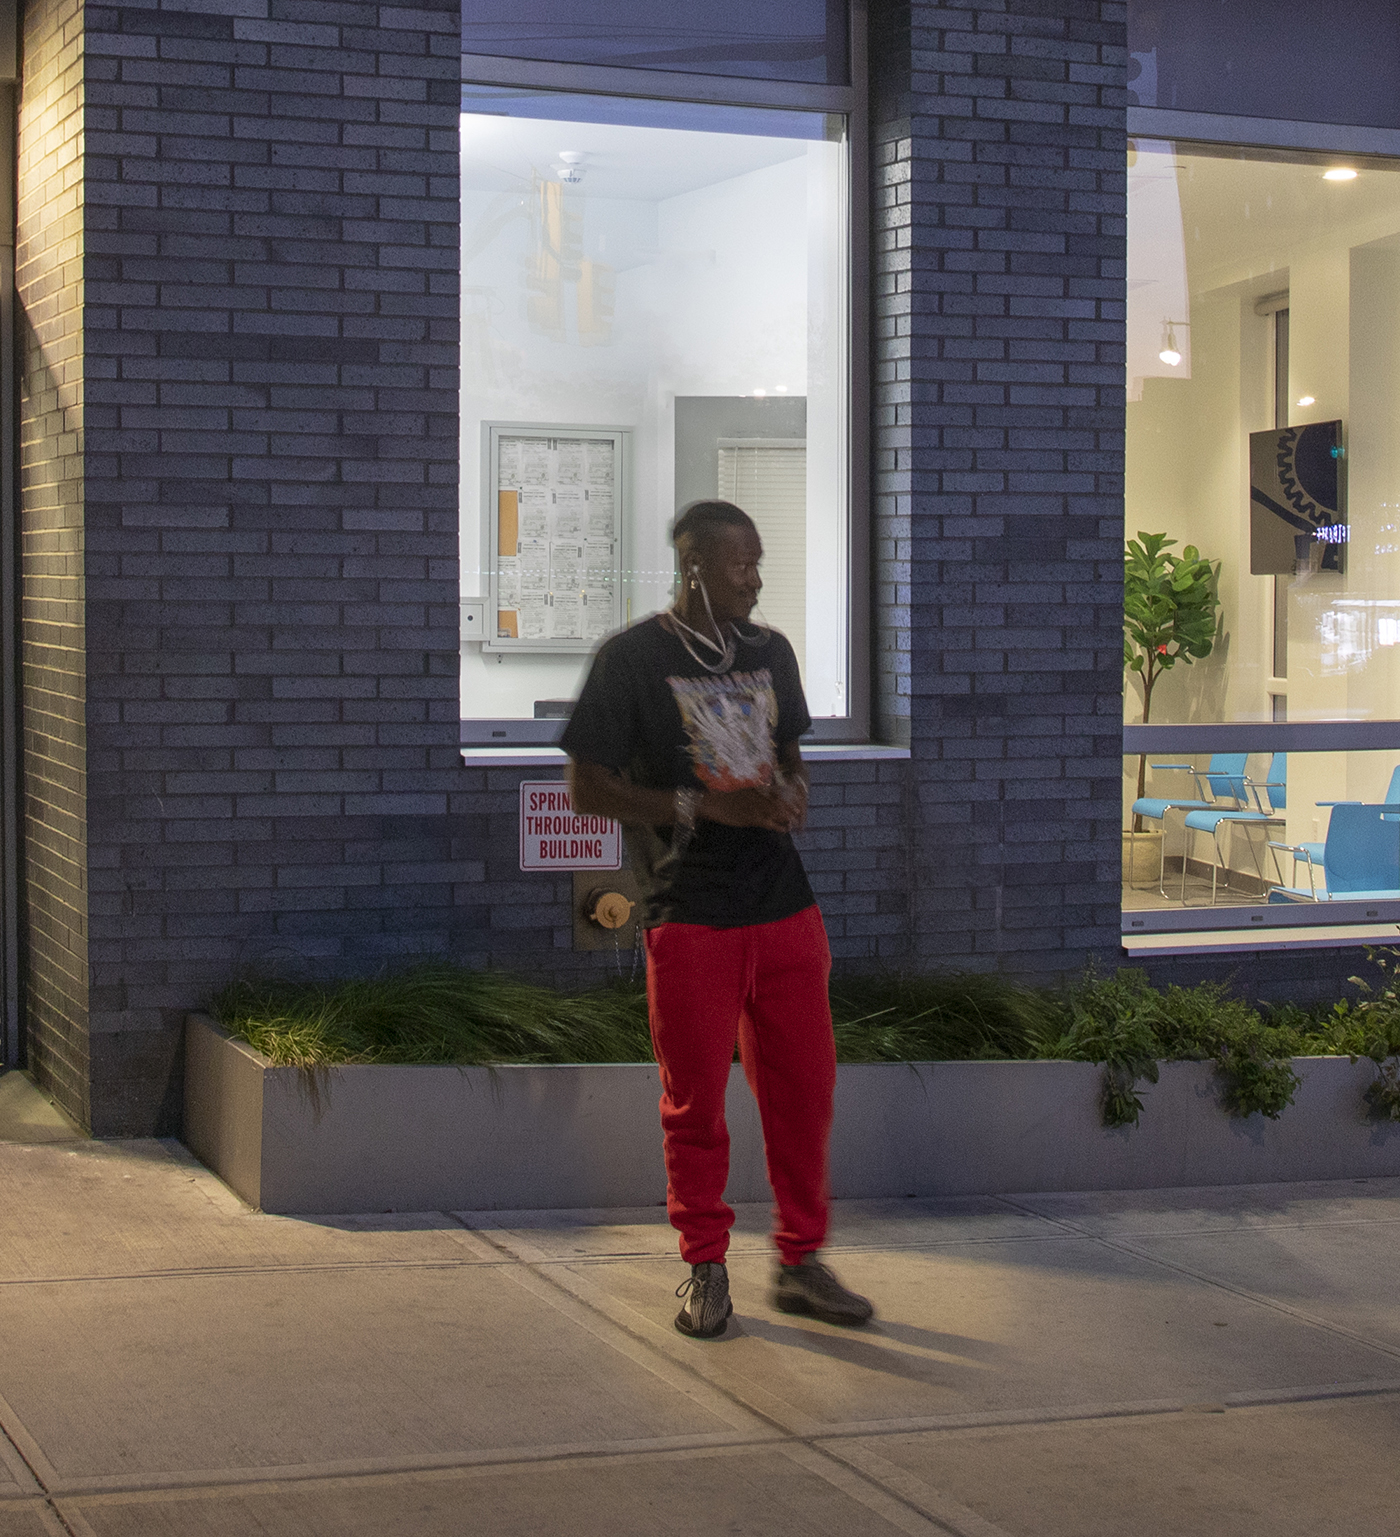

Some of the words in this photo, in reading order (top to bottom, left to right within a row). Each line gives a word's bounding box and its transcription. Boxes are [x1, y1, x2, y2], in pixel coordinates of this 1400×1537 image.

[530, 792, 570, 811] SPRIN
[526, 815, 614, 835] THROUGHOUT
[540, 839, 602, 859] BUILDING
